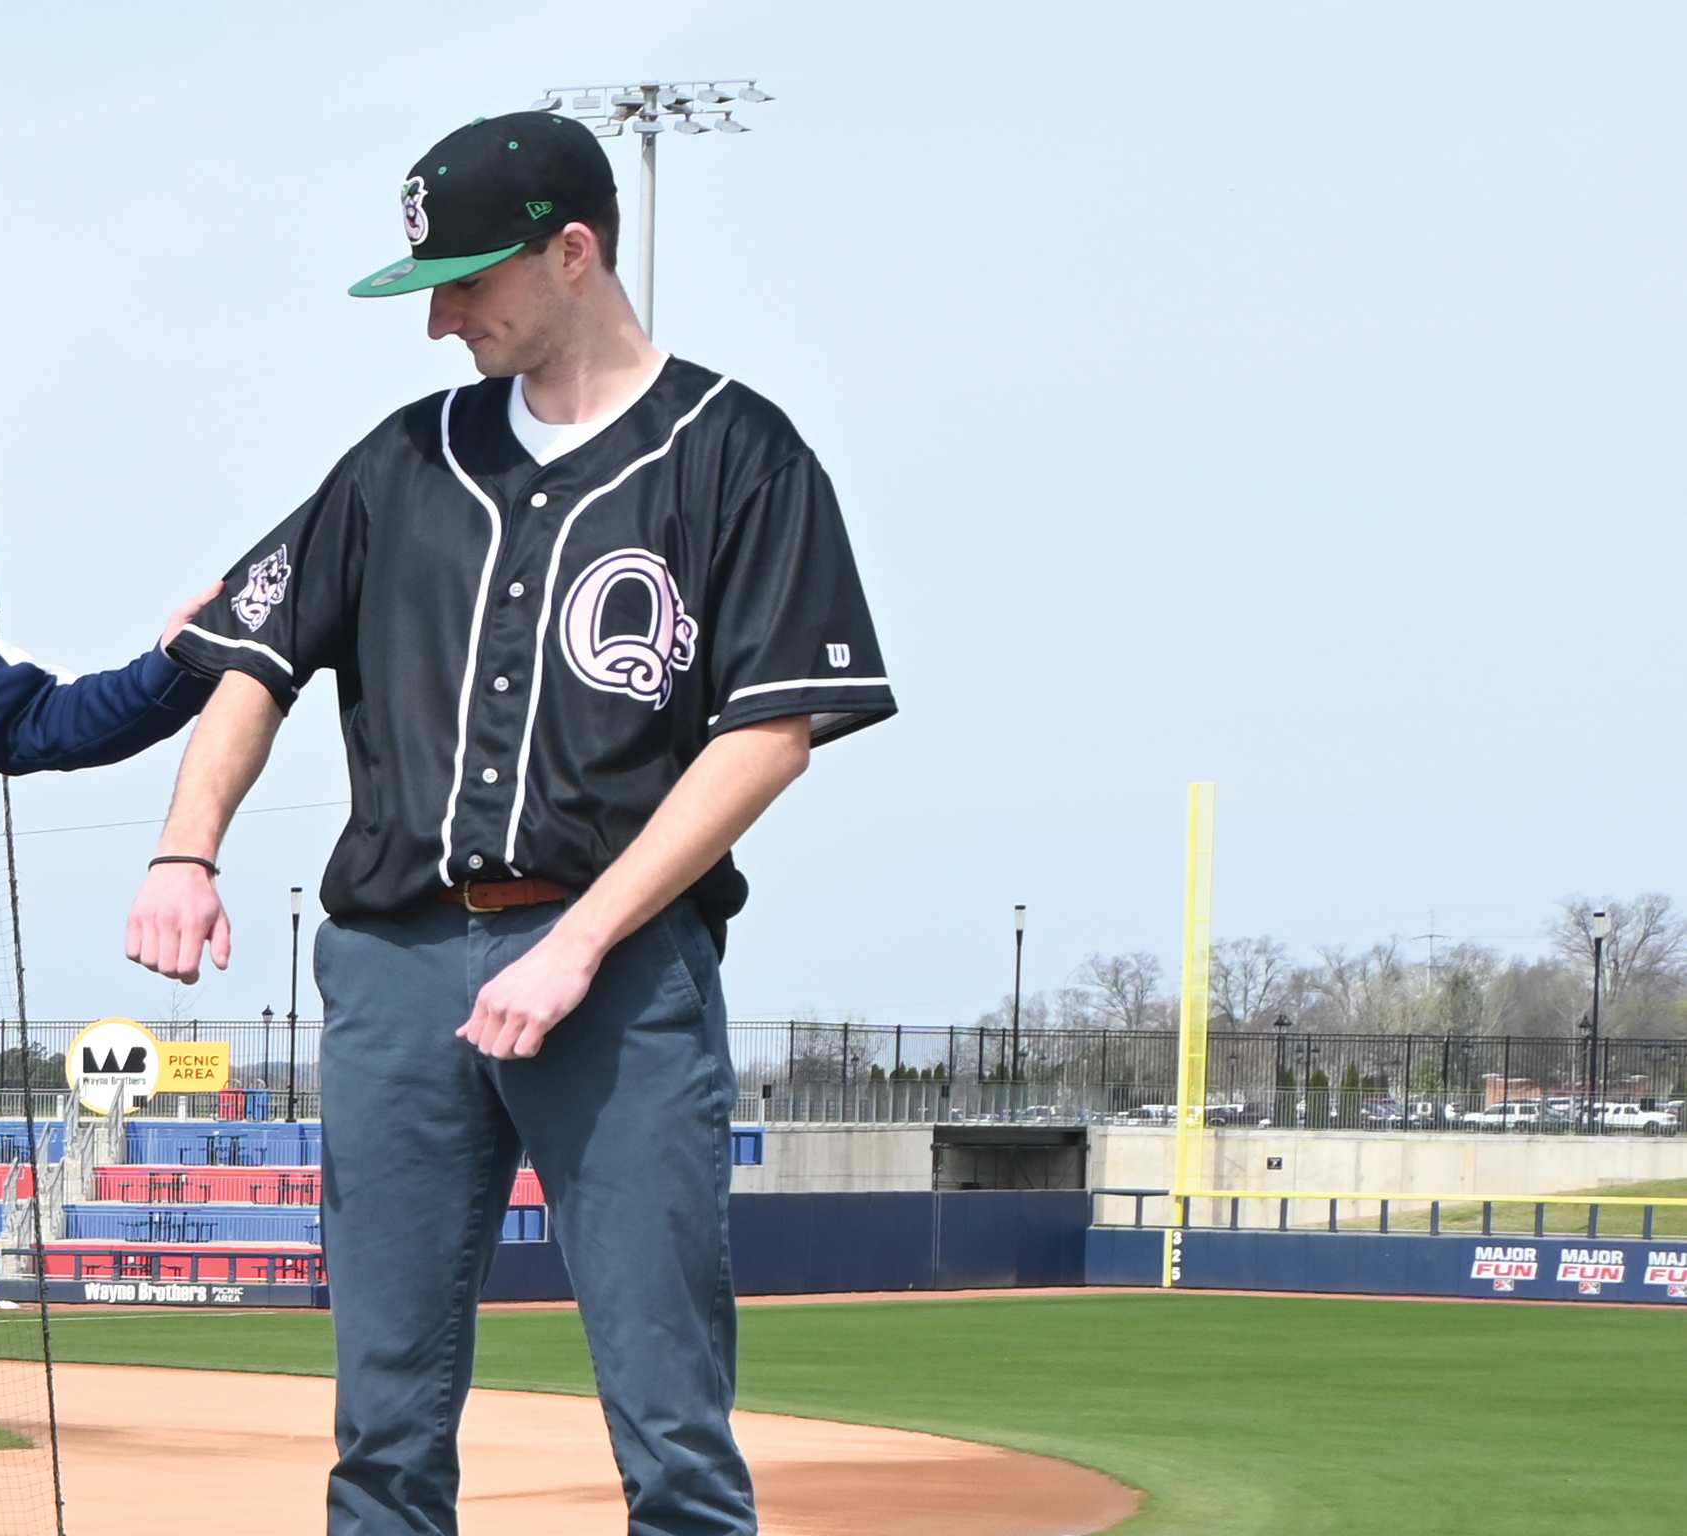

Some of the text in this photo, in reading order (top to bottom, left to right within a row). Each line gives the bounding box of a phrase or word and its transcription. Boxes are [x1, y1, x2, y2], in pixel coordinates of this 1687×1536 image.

[168, 1055, 219, 1066] PICNIC
[172, 1068, 215, 1079] AREA
[1475, 1246, 1537, 1262] MAJOR
[1561, 1248, 1623, 1265] MAJOR
[1476, 1262, 1533, 1278] FUN
[1561, 1265, 1619, 1281] FUN
[84, 1282, 207, 1304] Wayne Brothers
[212, 1286, 245, 1295] PICNIC
[214, 1294, 241, 1303] AREA
